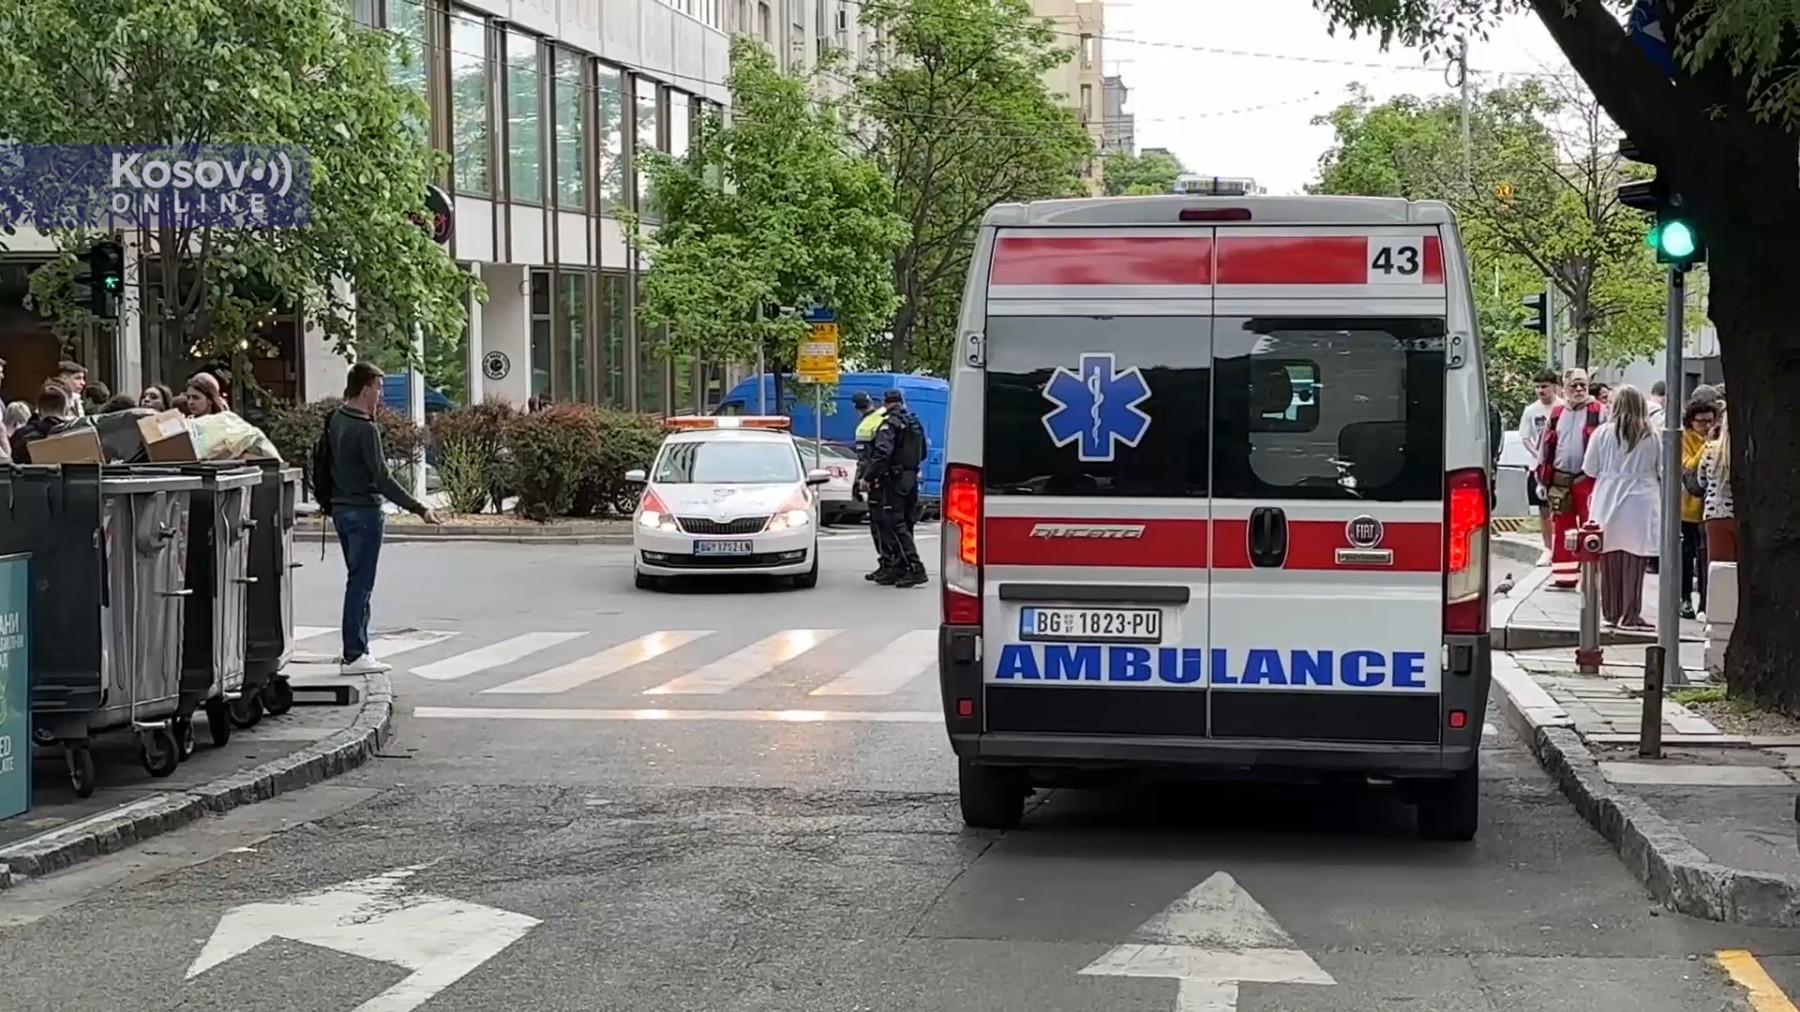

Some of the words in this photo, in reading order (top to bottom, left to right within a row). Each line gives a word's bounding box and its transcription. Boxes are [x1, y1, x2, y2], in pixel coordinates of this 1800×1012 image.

[1372, 246, 1419, 275] 43
[1355, 524, 1375, 540] FIAT
[1037, 612, 1061, 633] BG
[995, 644, 1426, 689] AMBULANCE
